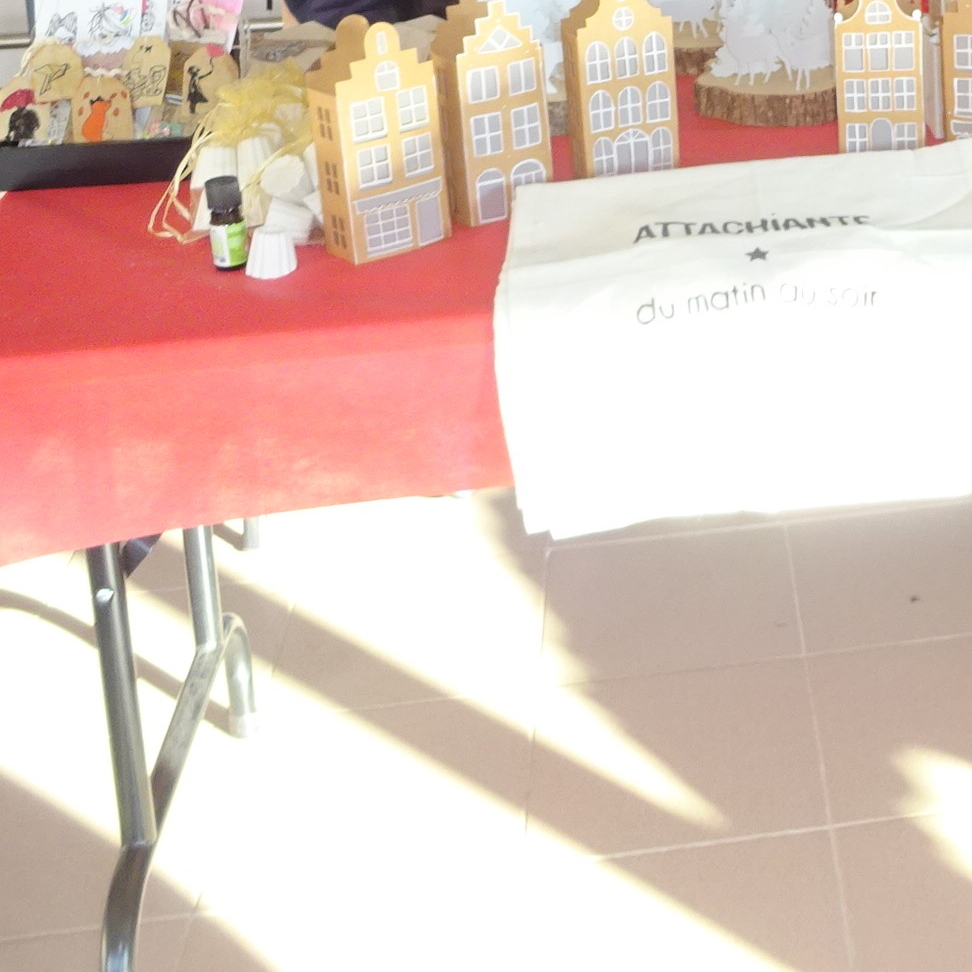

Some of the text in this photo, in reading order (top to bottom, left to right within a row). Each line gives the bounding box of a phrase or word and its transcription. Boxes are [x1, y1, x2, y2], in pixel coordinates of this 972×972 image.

[635, 280, 879, 325] du matin au soir
